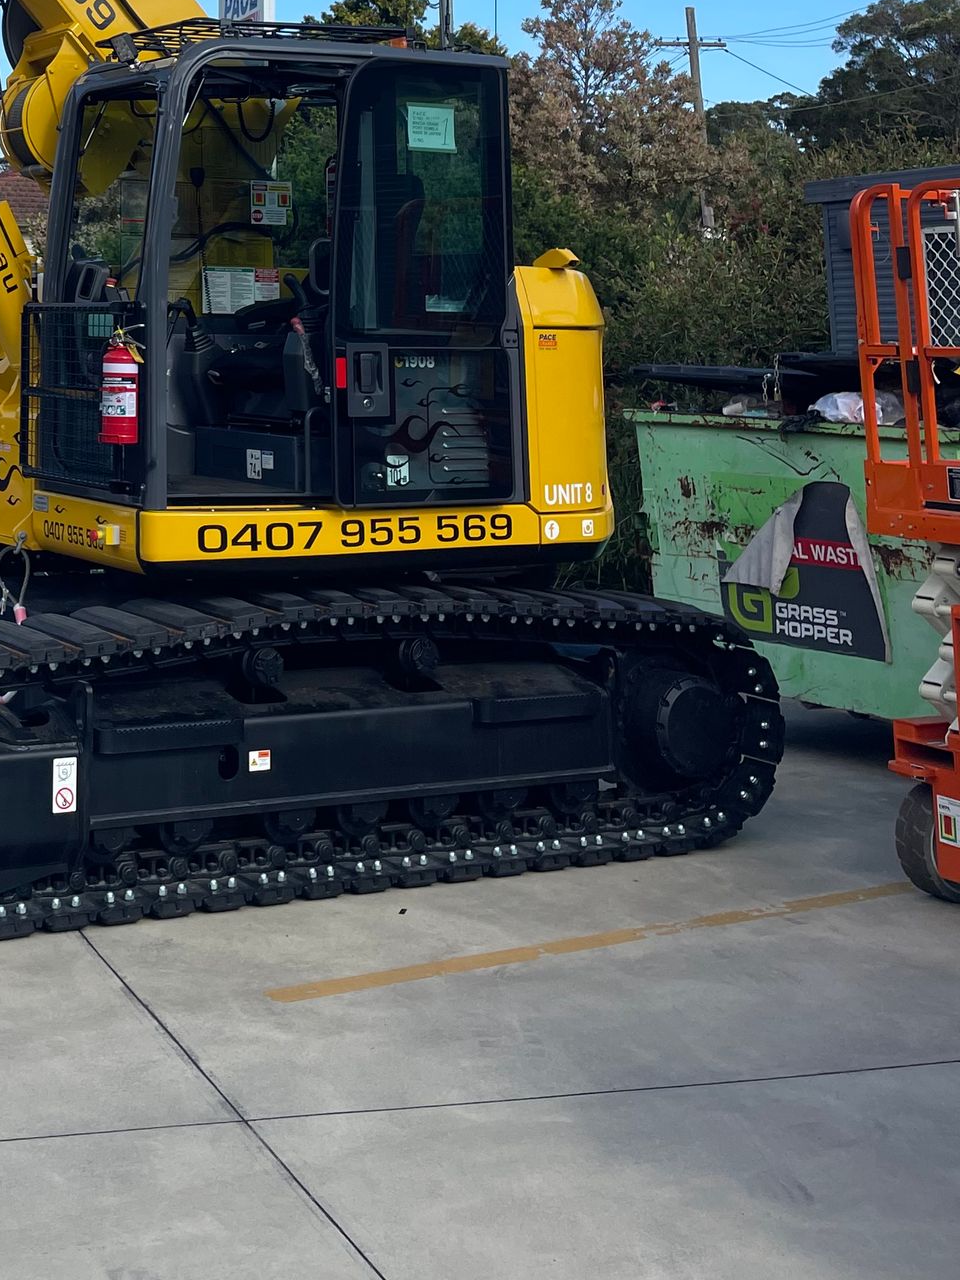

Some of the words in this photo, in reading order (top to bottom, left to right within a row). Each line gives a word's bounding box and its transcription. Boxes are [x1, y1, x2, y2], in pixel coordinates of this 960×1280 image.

[544, 483, 583, 506] UNIT
[585, 482, 593, 503] 8
[43, 519, 65, 541] 0407
[67, 525, 85, 546] 955
[197, 521, 323, 554] 0407
[340, 516, 421, 548] 955
[436, 513, 513, 543] 569
[775, 602, 838, 625] GRASS
[775, 619, 853, 647] HOPPER
